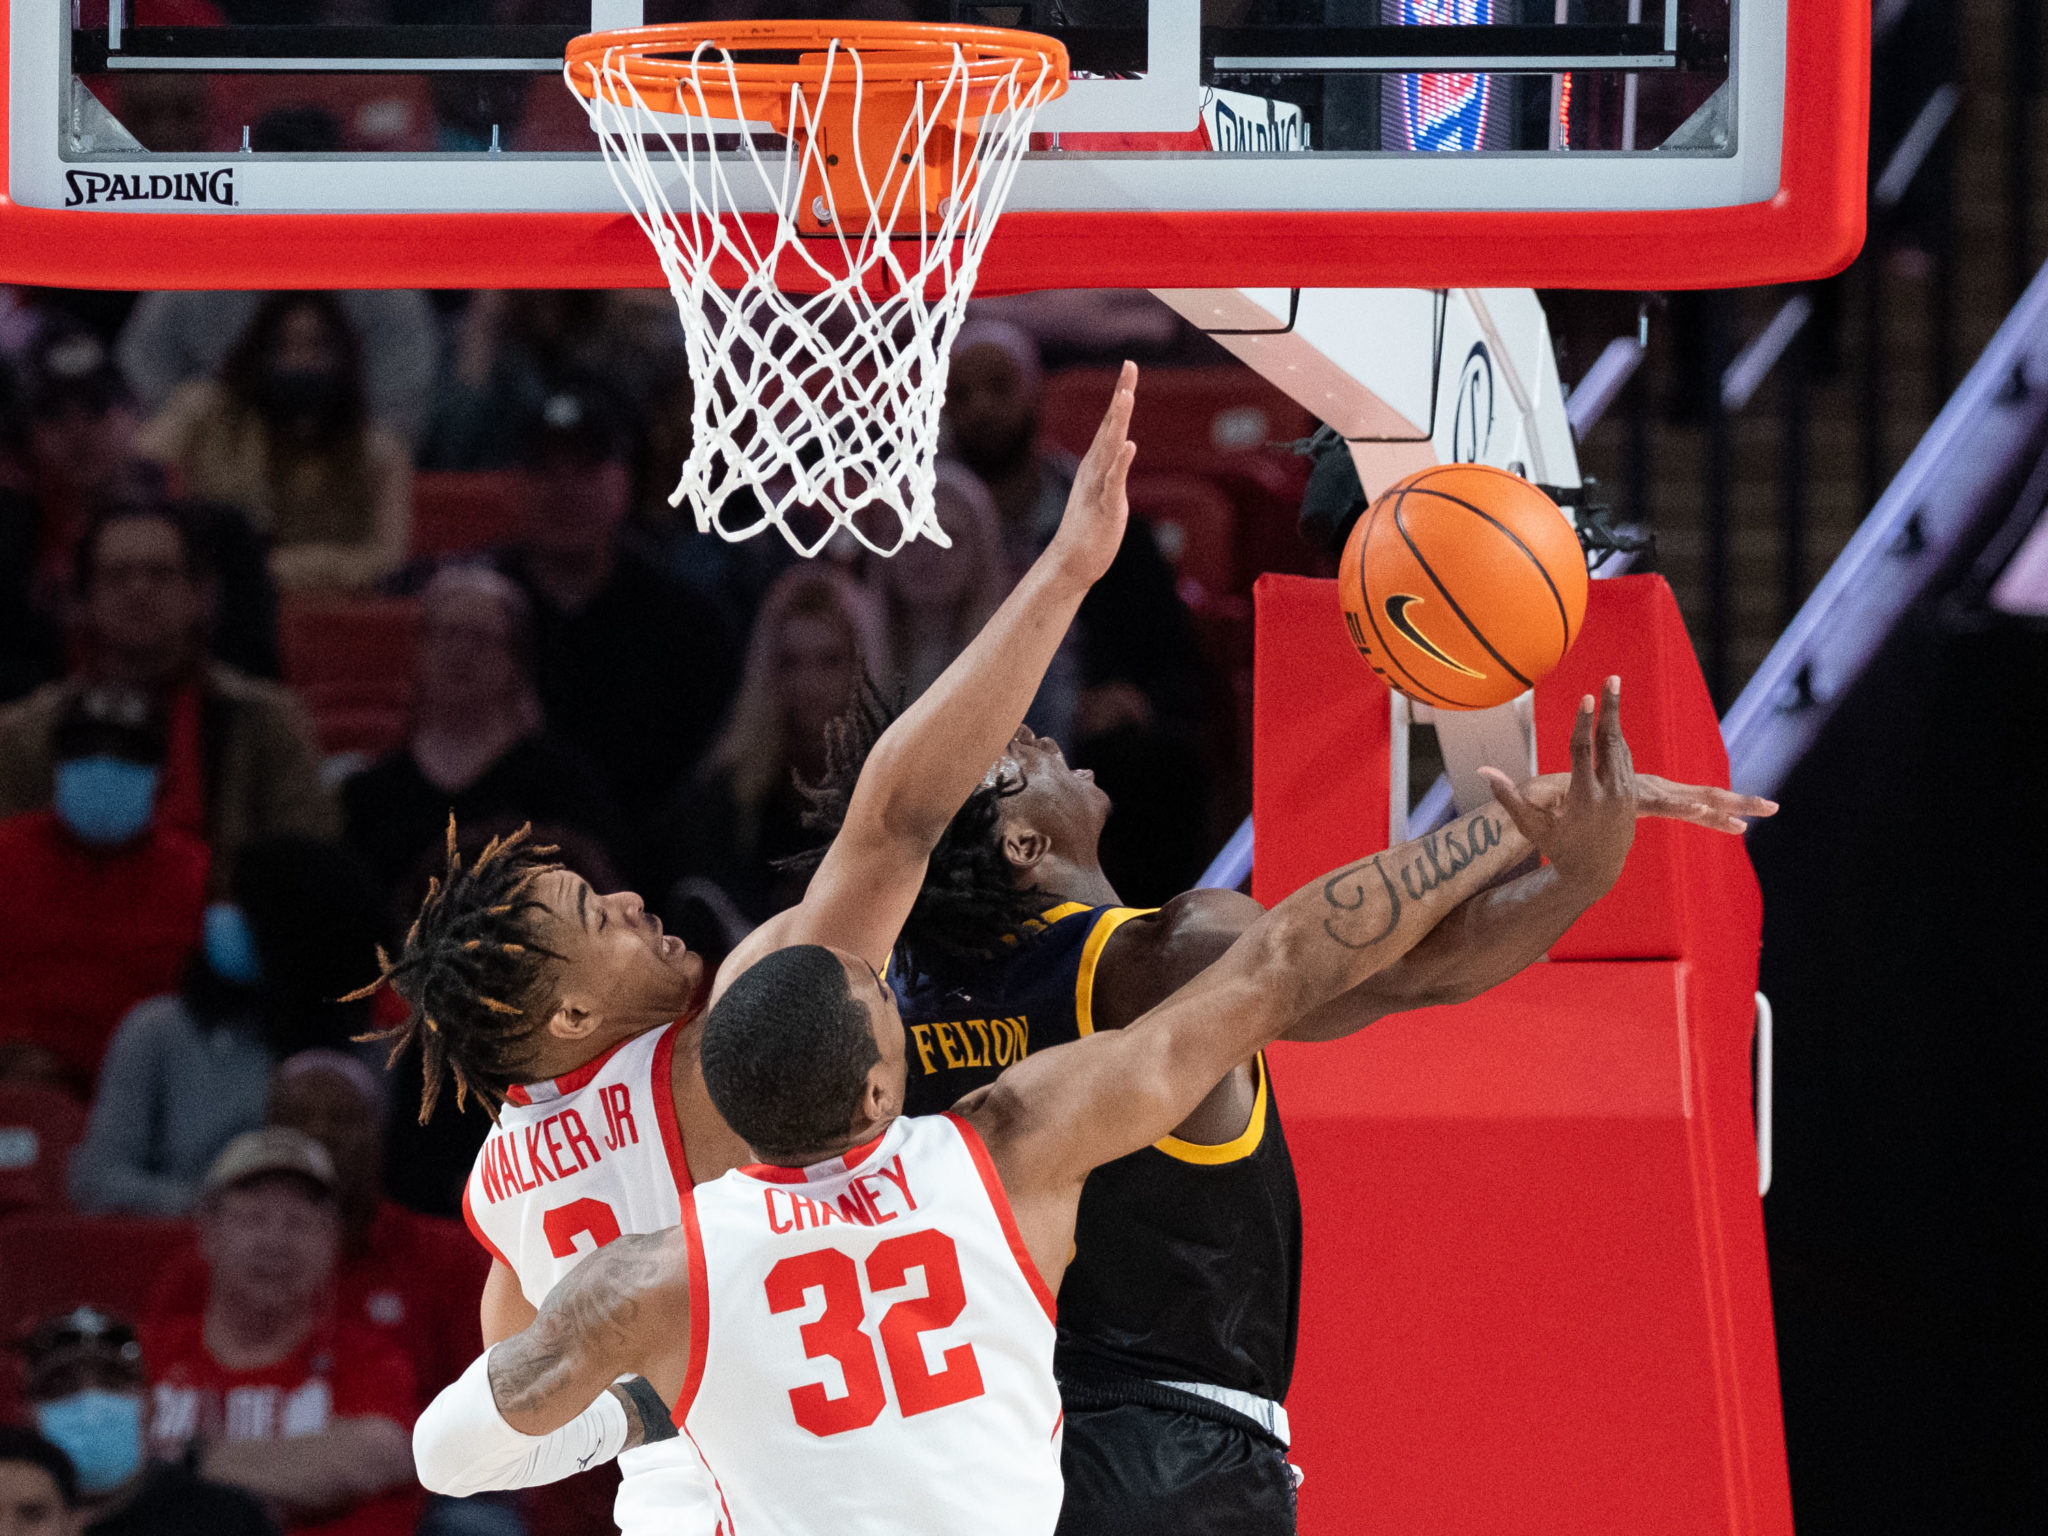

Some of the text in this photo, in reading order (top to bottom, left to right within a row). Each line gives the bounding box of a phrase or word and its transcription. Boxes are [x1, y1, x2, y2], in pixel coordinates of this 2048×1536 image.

[65, 168, 233, 207] SPALDING
[910, 1015, 1029, 1076] FELTON
[481, 1083, 639, 1204] WALKER JR
[764, 1154, 917, 1235] CHANEY
[764, 1228, 985, 1437] 32
